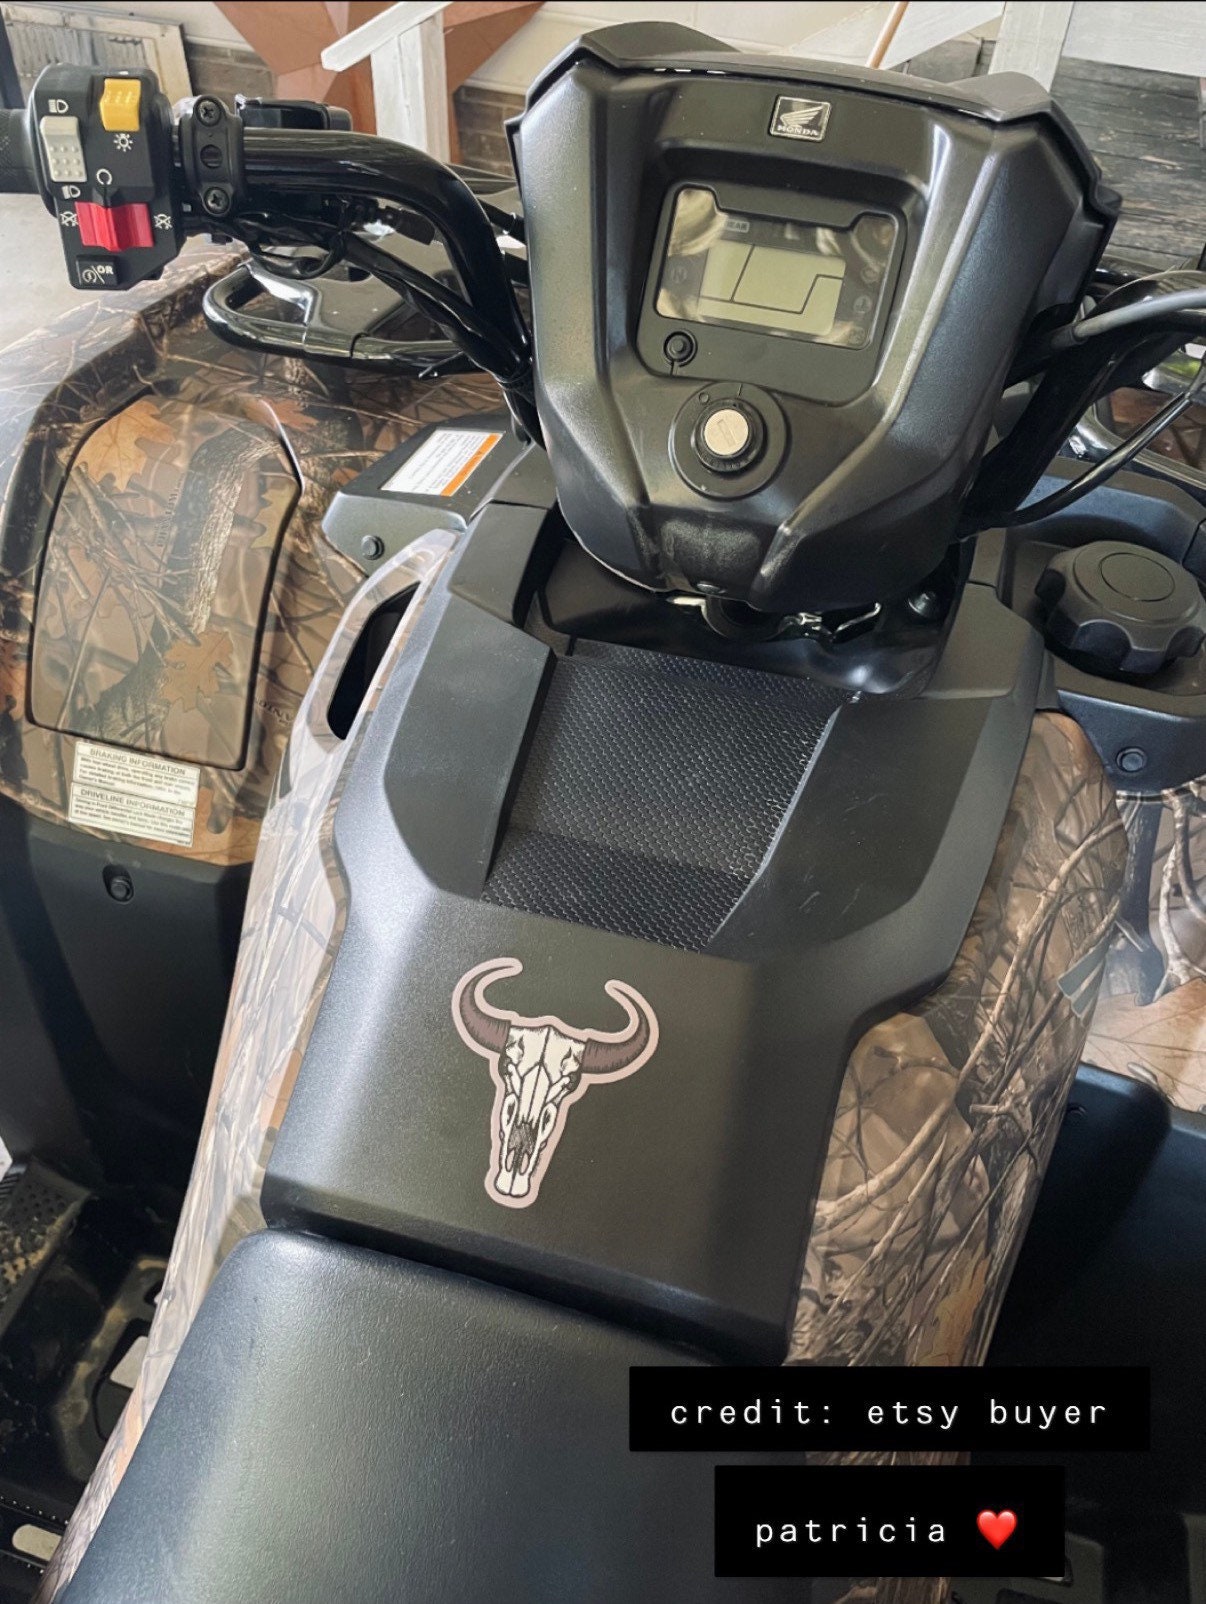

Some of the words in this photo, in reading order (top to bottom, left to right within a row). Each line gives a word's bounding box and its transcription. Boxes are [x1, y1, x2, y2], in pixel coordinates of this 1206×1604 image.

[777, 125, 819, 136] HONDA
[89, 748, 128, 763] BRAKING
[128, 755, 186, 776] INFORMATION
[80, 788, 125, 804] DRIVELINE
[125, 798, 186, 817] INFORMATION
